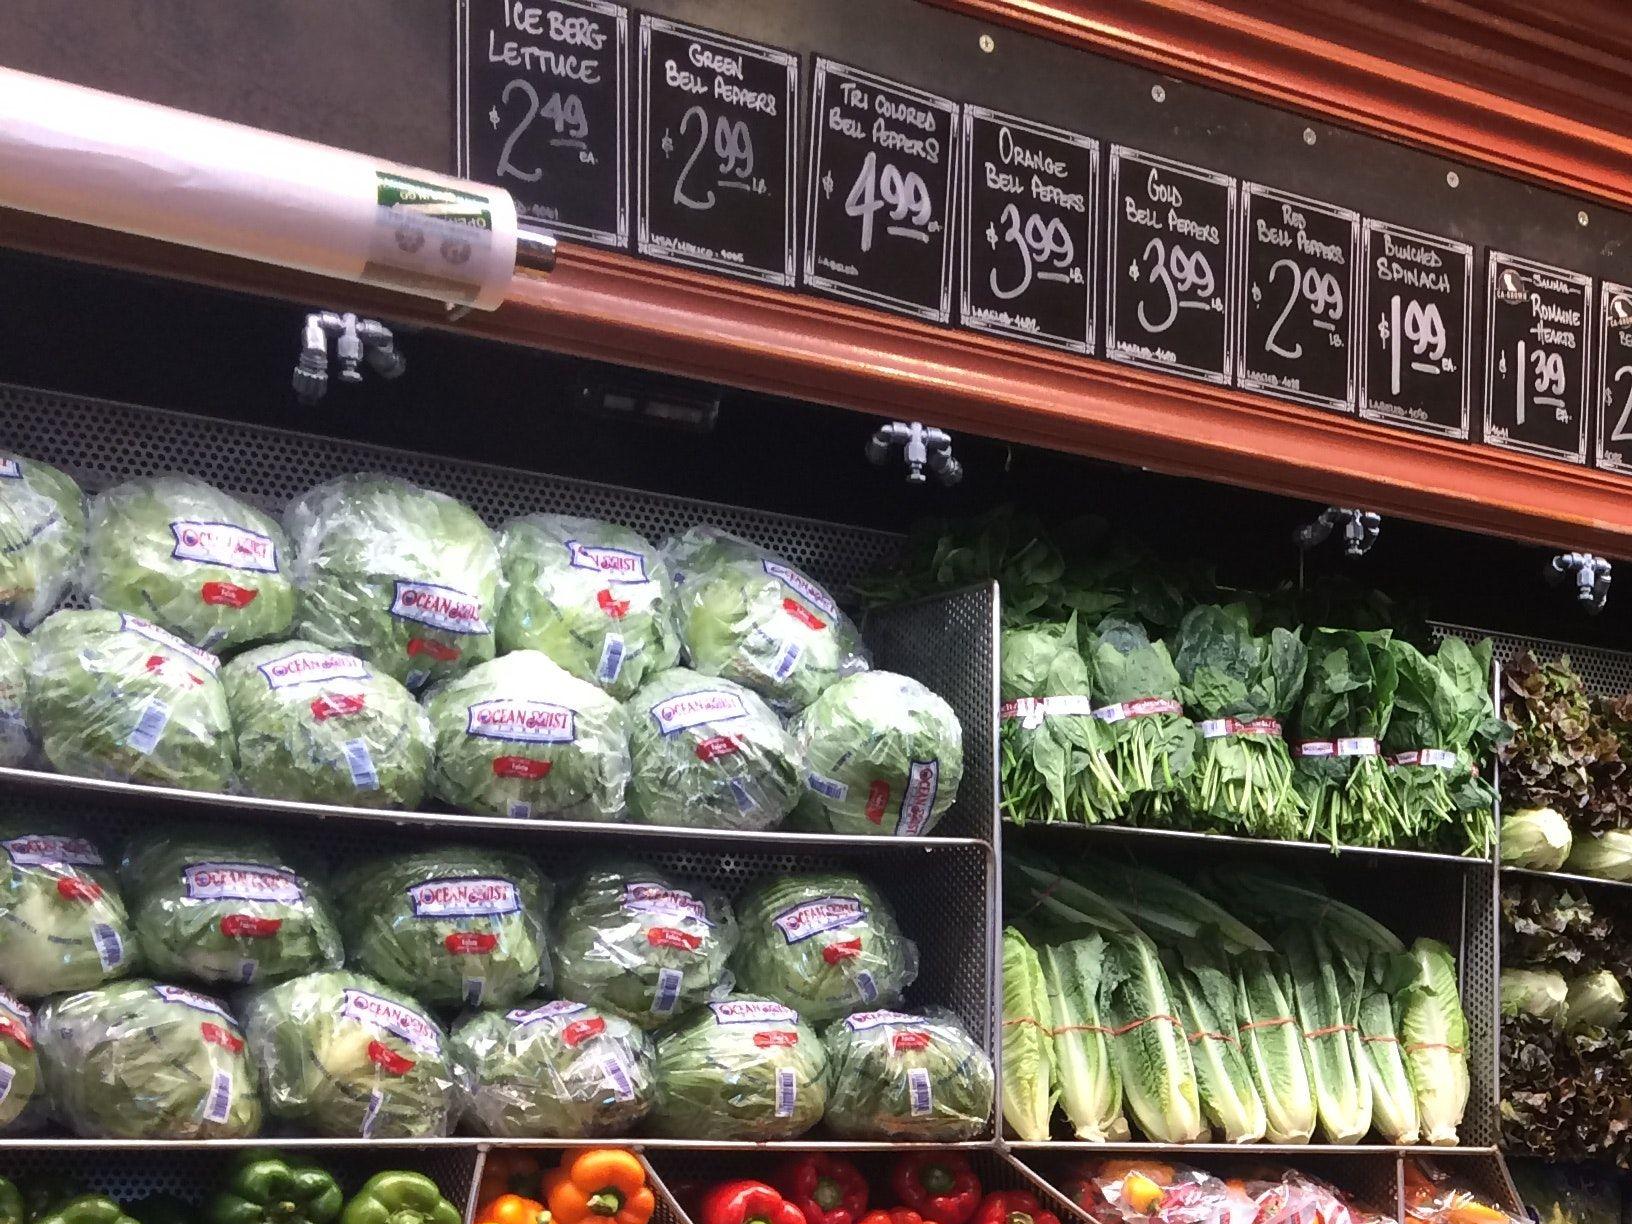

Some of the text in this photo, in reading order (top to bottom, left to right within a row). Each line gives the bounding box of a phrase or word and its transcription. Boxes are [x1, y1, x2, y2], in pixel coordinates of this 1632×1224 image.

[489, 30, 601, 84] LETTUCE
[689, 44, 744, 80] GREEN
[665, 60, 777, 116] BELL PEPPERS
[840, 82, 936, 131] TRI COLORED
[829, 106, 940, 164] BELL PEPPERS
[999, 127, 1068, 178] ORANGE
[984, 162, 1085, 213] BELL PEPPERS
[1148, 167, 1182, 207] GOLD
[1125, 196, 1219, 244] BELL PEPPERS
[1282, 204, 1306, 229] RED
[1257, 218, 1345, 264] BELL PEPPERS
[1384, 234, 1442, 267] BUNCHED
[1376, 257, 1450, 293] SPINACH
[1531, 293, 1581, 327] ROMAINE
[1530, 322, 1576, 348] HEARTS
[402, 589, 452, 614] OCEAN
[477, 708, 526, 726] OCEAN
[419, 886, 467, 905] OCEAN
[353, 995, 400, 1021] OCEAN
